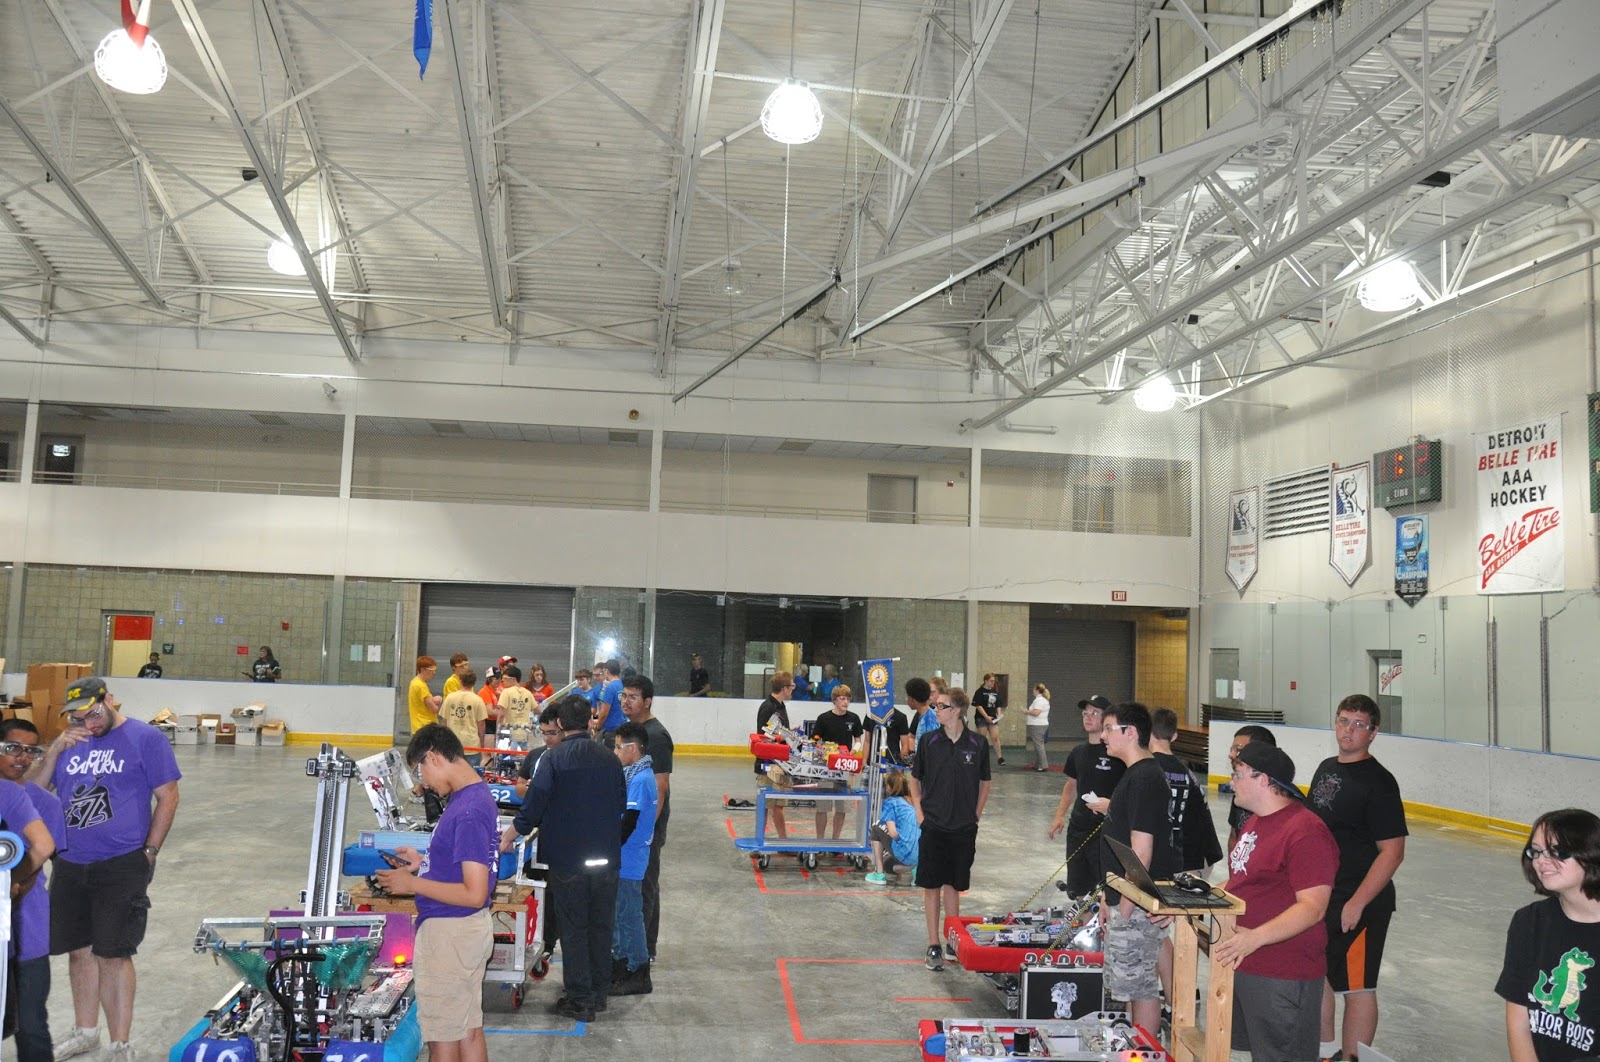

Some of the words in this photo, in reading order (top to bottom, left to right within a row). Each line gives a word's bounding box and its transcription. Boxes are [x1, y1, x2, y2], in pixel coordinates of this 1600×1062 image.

[1488, 423, 1546, 450] DETROIT
[1478, 449, 1519, 471] BELLE
[1502, 468, 1533, 487] AAA
[1491, 485, 1547, 508] HOCKEY
[1478, 520, 1528, 566] Belle
[1522, 506, 1560, 542] Tire
[834, 758, 859, 771] 4390
[1566, 1021, 1594, 1047] BOTS
[1566, 1037, 1590, 1052] 1250
